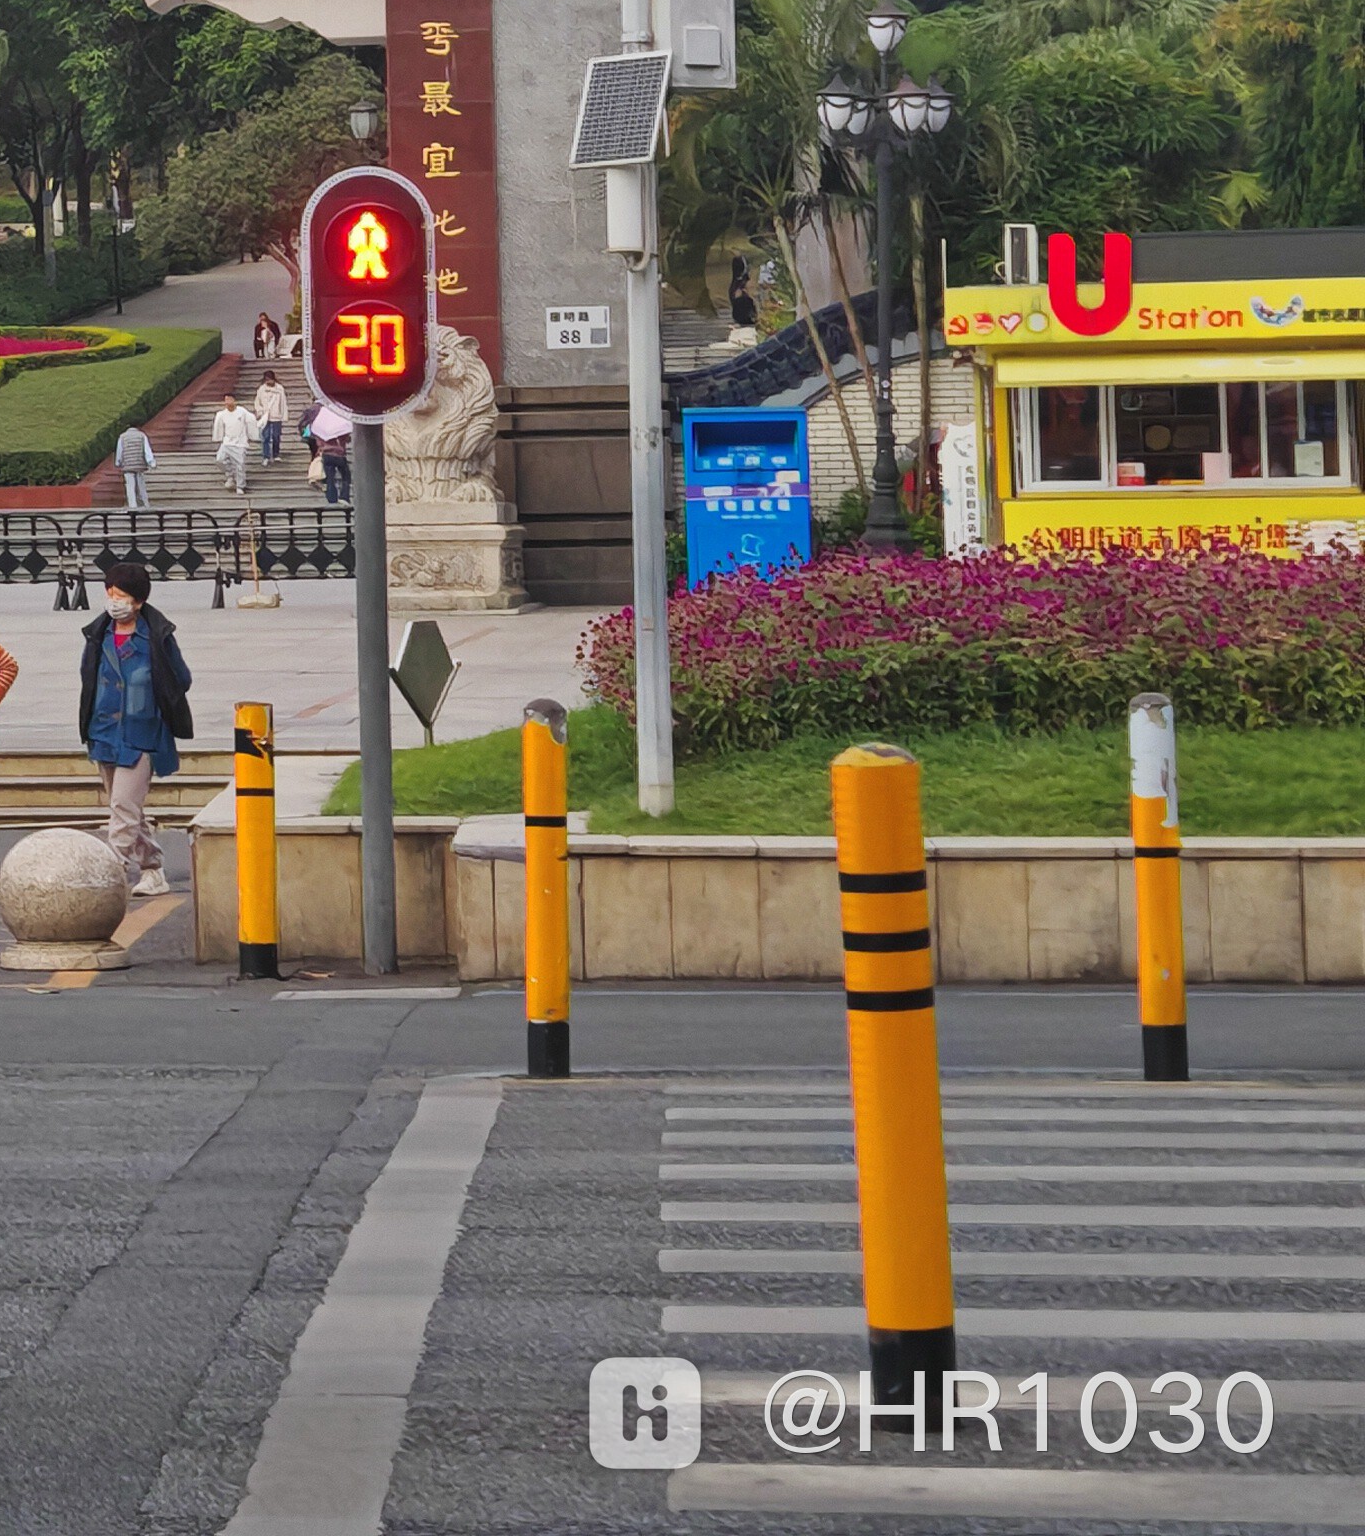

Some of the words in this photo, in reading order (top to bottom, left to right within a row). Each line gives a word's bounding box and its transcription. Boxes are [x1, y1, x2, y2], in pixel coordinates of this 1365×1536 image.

[1048, 233, 1132, 336] U
[336, 314, 406, 375] 20
[559, 329, 581, 344] 88
